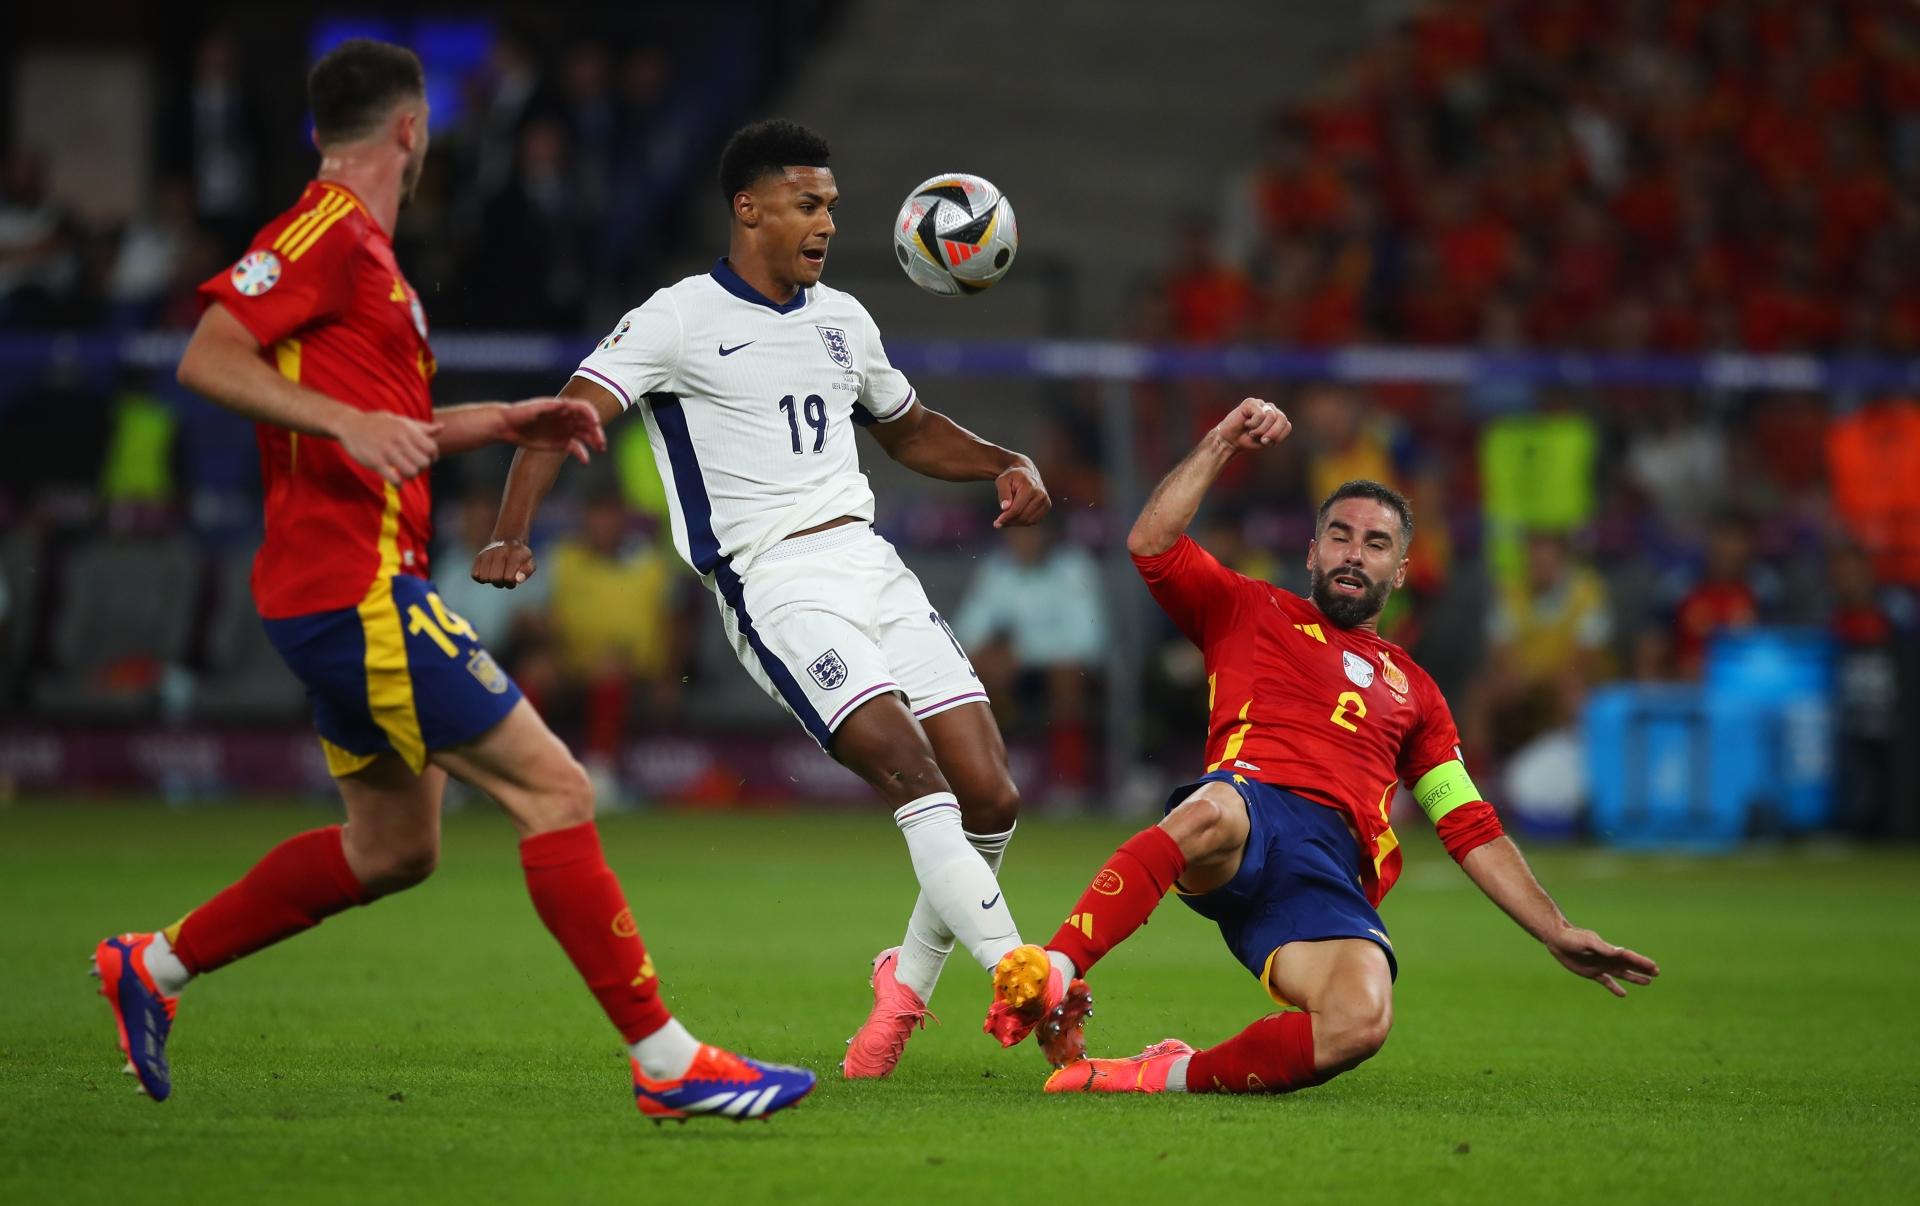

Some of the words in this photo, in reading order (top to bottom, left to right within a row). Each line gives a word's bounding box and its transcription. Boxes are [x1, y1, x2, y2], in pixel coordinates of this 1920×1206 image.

[779, 394, 829, 454] 19
[407, 592, 478, 658] 14
[1330, 692, 1367, 733] 2
